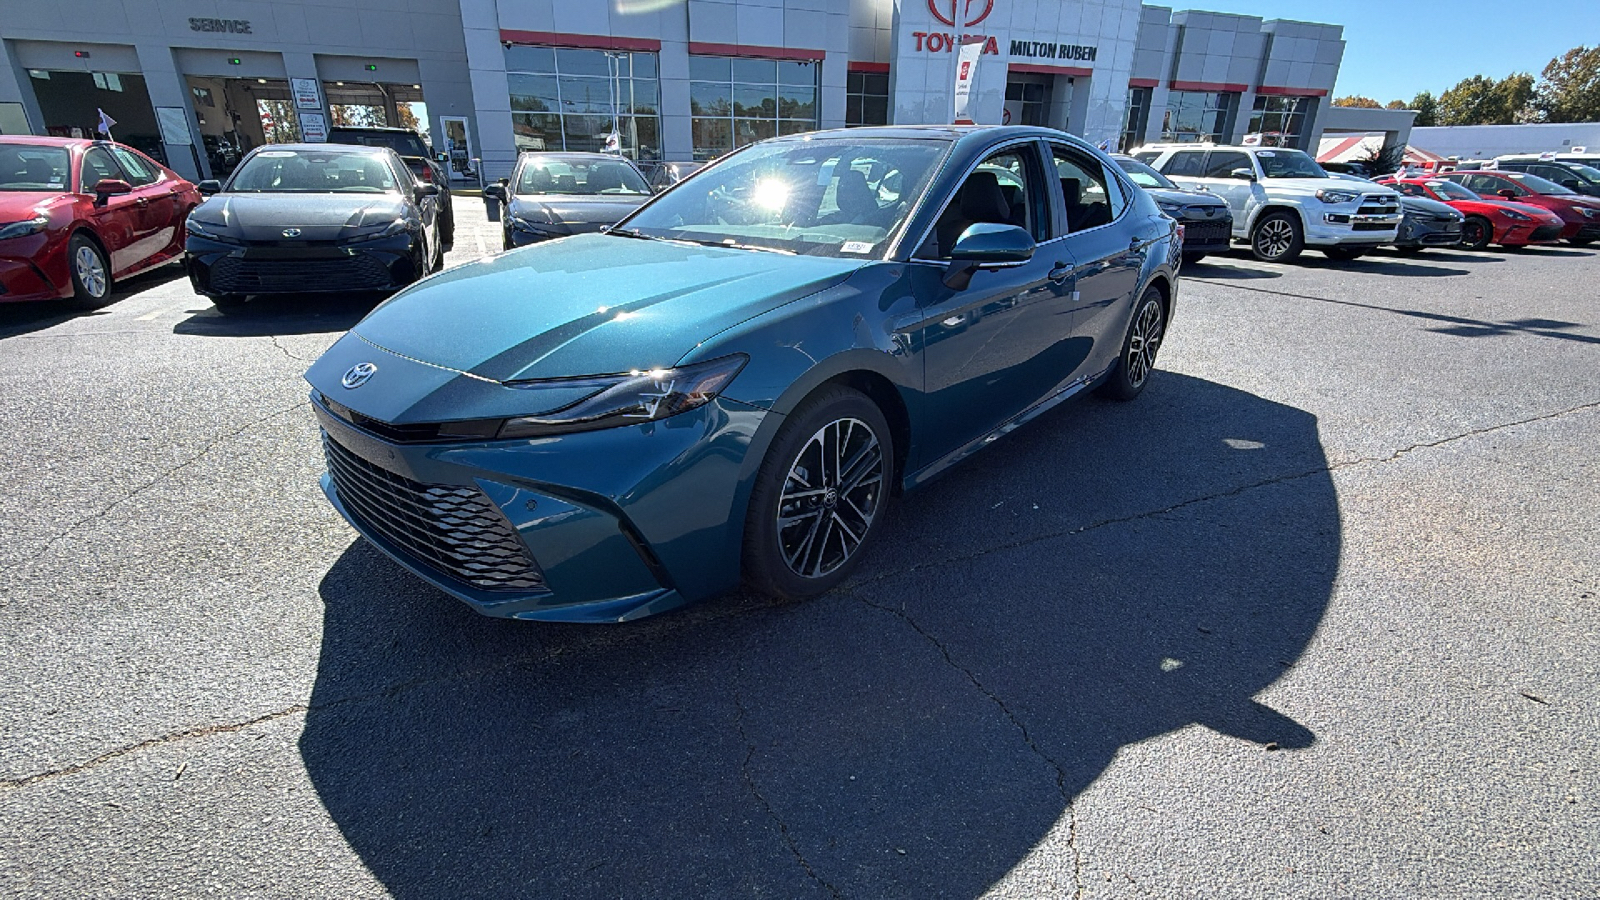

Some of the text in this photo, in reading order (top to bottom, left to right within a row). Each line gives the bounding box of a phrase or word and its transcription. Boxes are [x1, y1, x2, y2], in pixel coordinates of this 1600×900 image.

[188, 17, 253, 34] SERVICE
[913, 32, 999, 55] TOYA
[1009, 39, 1098, 61] MILTON RUBEN
